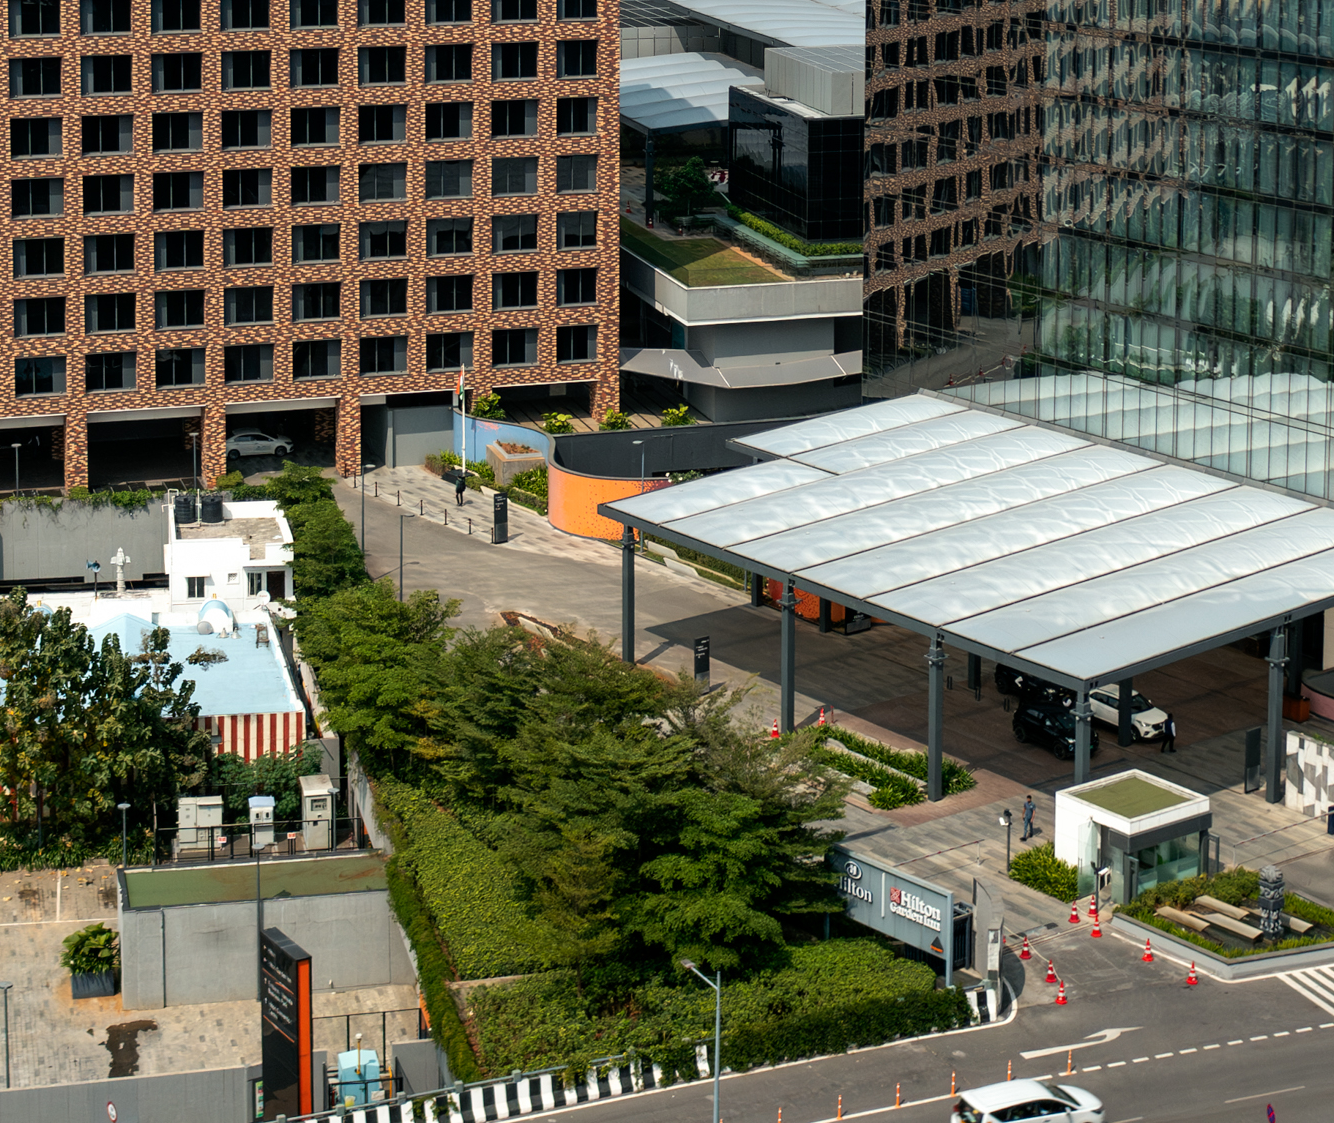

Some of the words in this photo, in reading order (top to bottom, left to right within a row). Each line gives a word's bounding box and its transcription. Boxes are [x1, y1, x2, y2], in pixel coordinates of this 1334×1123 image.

[889, 901, 924, 926] Garden
[923, 914, 942, 933] Inn
[901, 890, 942, 922] Hilton
